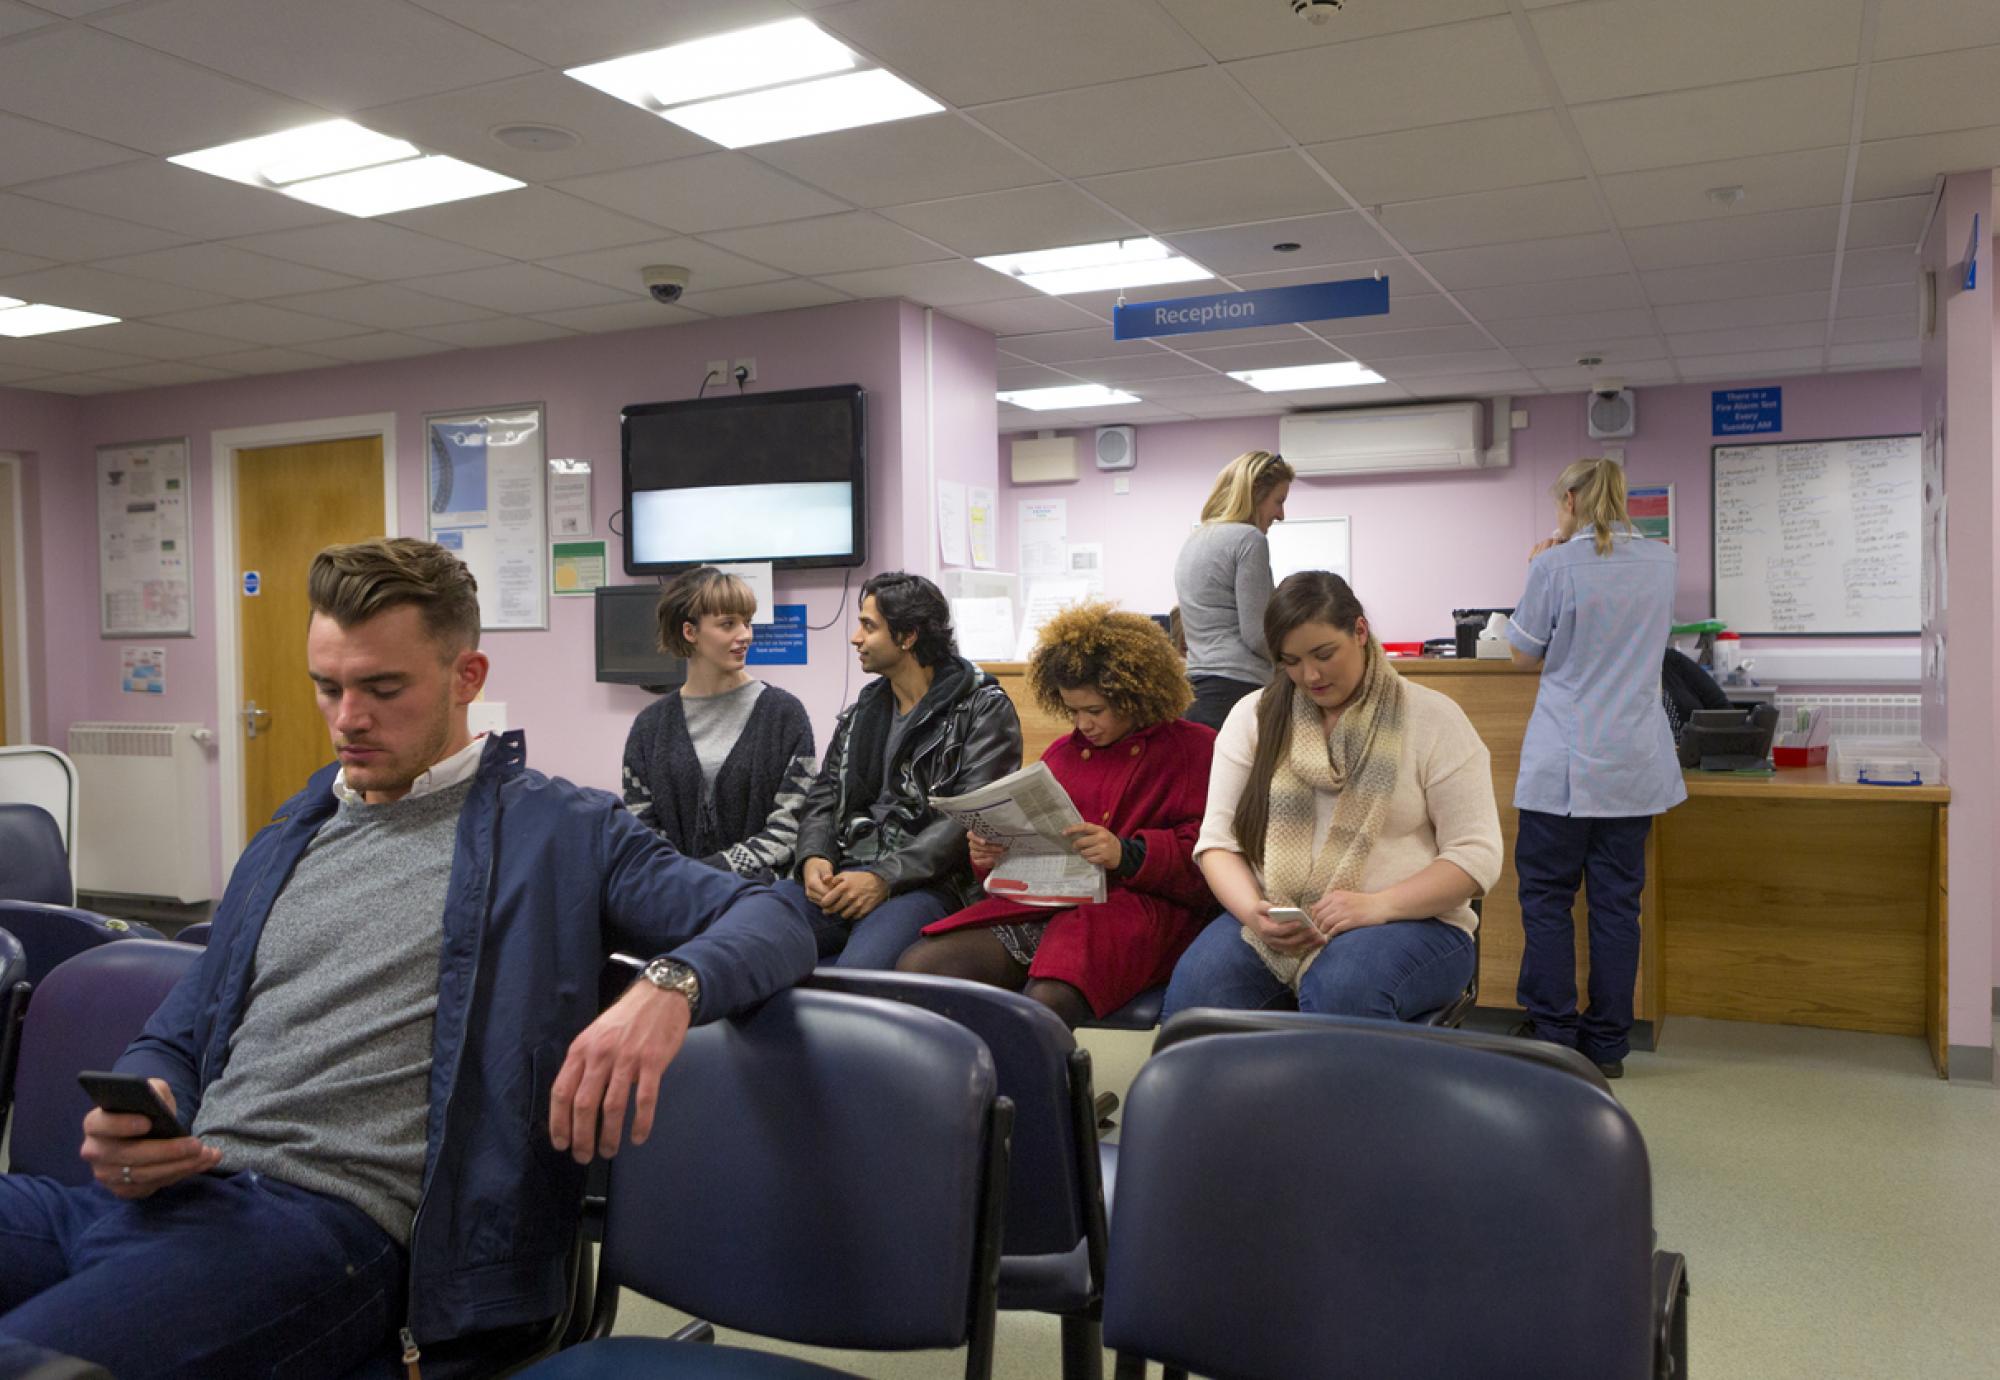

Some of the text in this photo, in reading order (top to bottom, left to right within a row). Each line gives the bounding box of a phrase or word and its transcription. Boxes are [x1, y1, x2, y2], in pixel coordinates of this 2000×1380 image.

[1155, 301, 1255, 325] Reception
[1727, 392, 1749, 400] There
[1734, 402, 1759, 410] Alarm
[1761, 400, 1776, 408] Test
[1735, 413, 1759, 421] Every
[1722, 420, 1772, 432] Tuesday AM
